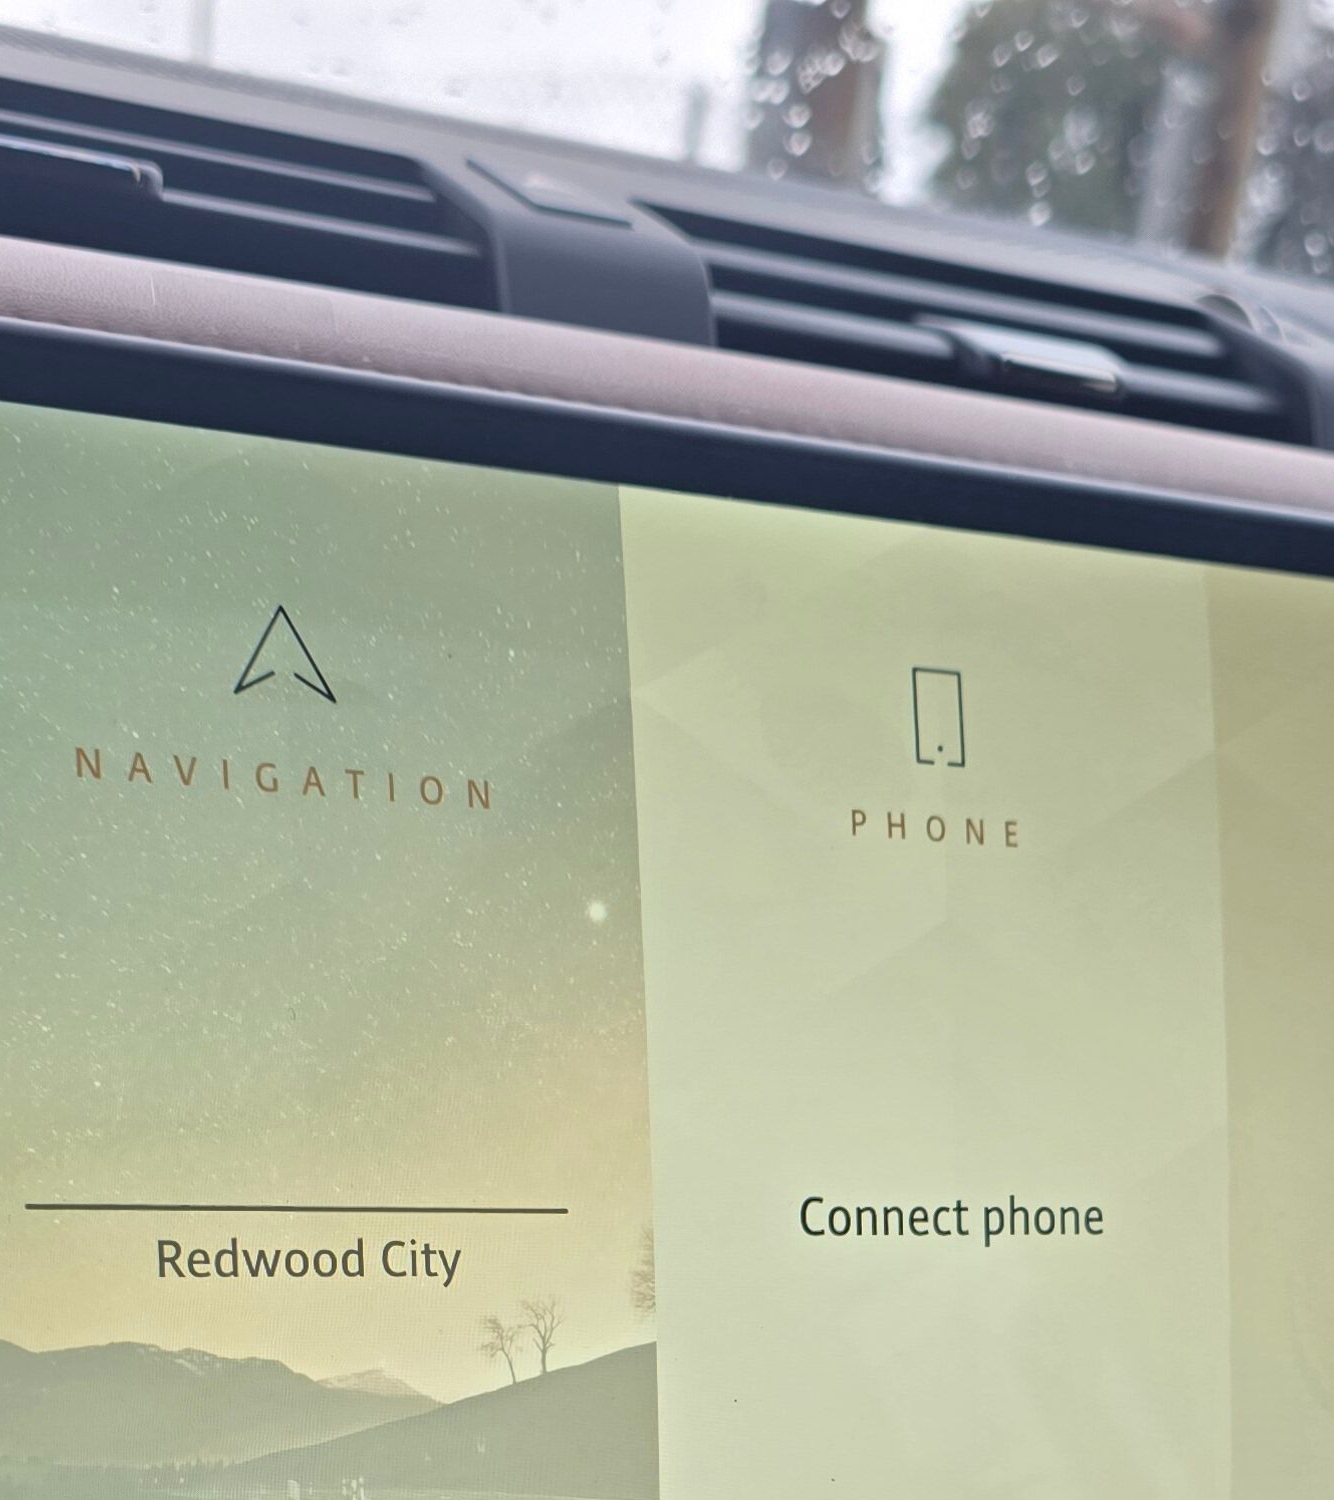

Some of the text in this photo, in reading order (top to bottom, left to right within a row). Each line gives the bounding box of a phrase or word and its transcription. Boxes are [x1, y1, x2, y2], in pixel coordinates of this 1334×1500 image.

[75, 746, 491, 810] NAVIGATION
[851, 809, 1018, 848] PHONE
[800, 1195, 1104, 1247] Connect phone
[157, 1238, 462, 1287] Redwood City
